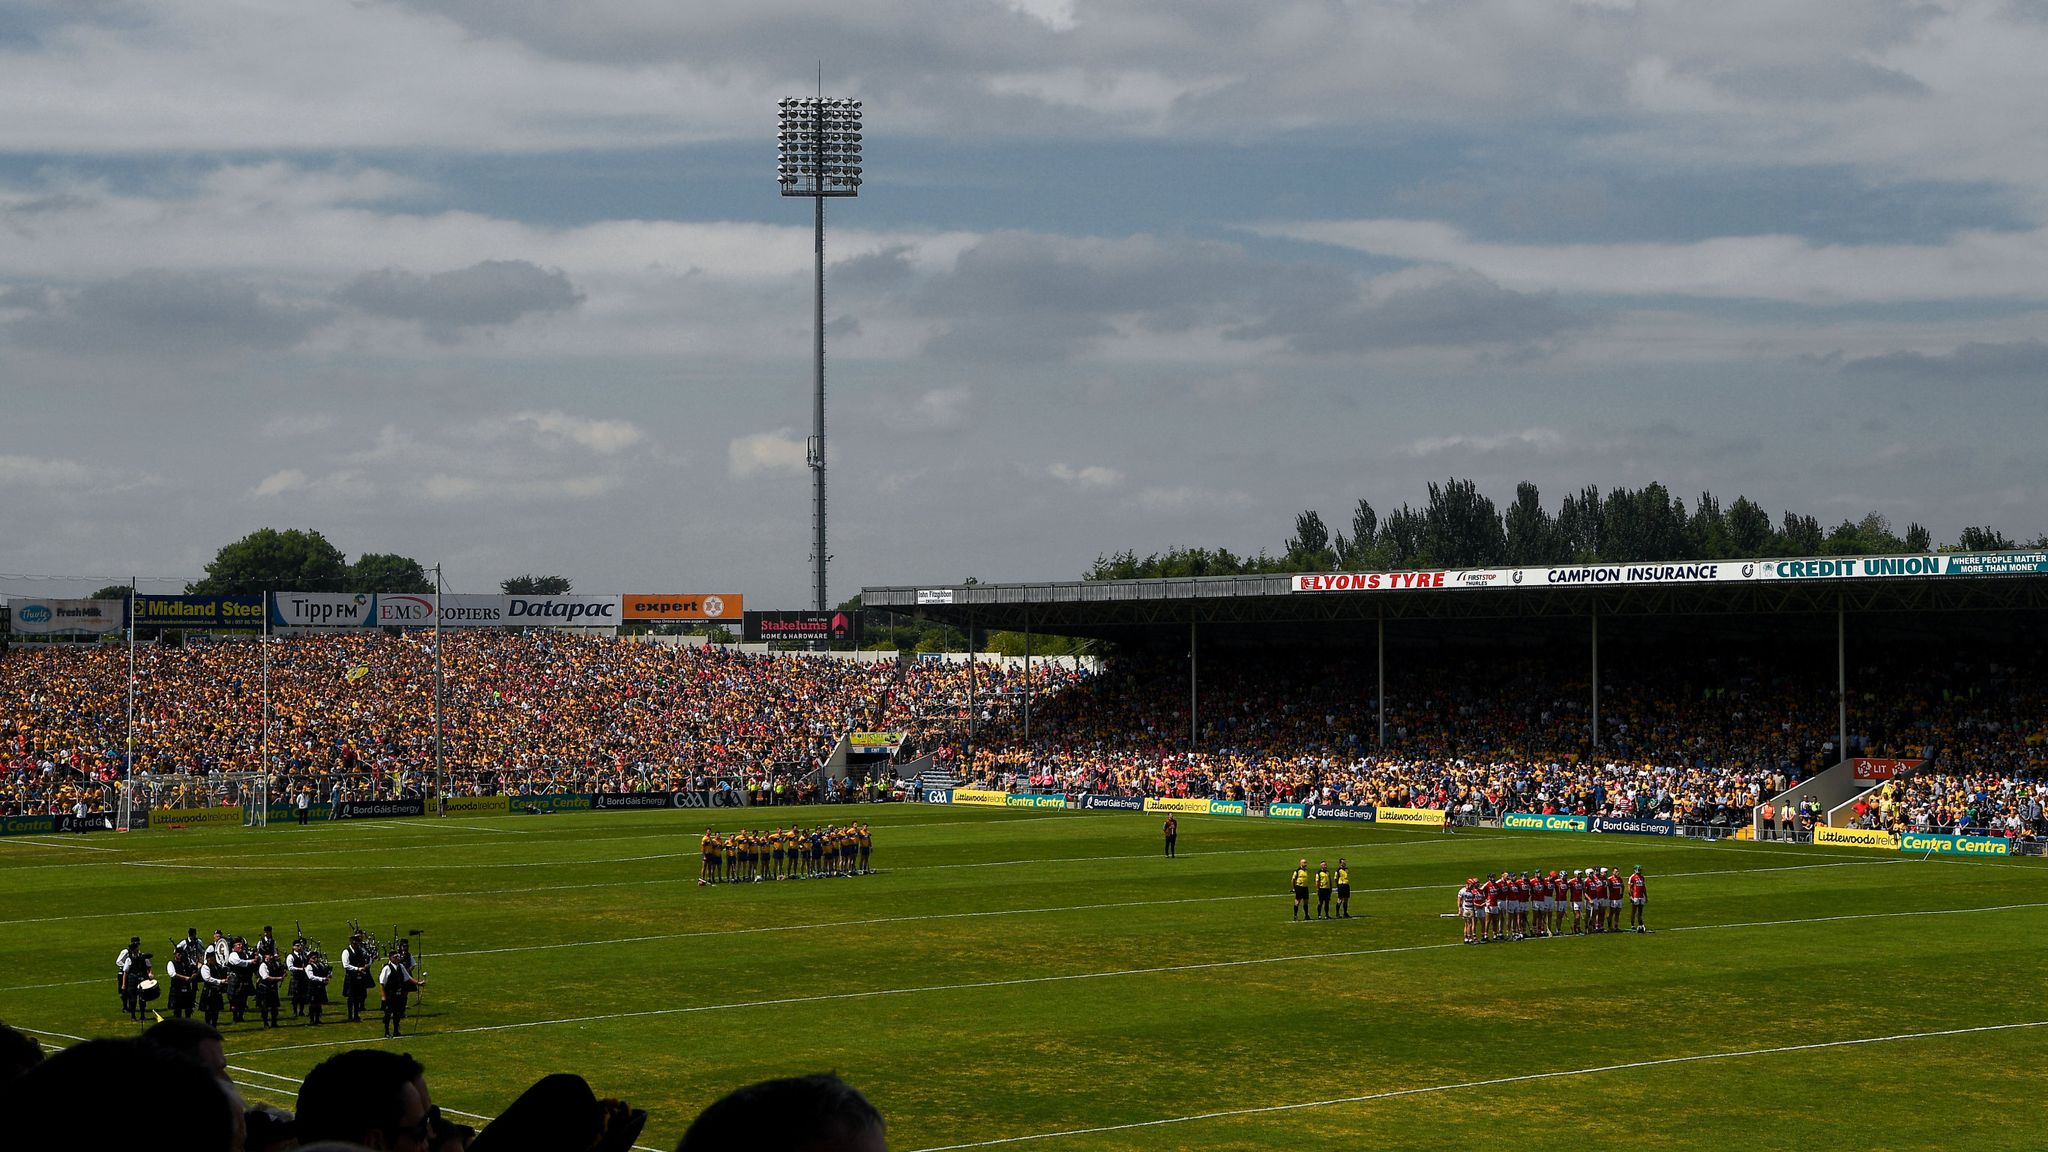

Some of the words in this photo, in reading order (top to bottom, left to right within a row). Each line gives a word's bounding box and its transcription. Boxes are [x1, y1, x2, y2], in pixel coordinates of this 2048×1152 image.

[1952, 557, 1980, 565] WHERE
[1981, 556, 2012, 564] PEOPLE
[2014, 554, 2047, 563] MATTER
[1776, 560, 1856, 578] CREDIT
[1864, 557, 1940, 576] UNION
[1960, 565, 1983, 573] MORE
[1985, 564, 2007, 572] THAN
[2009, 563, 2038, 571] MONEY
[1547, 568, 1620, 583] CAMPION
[1626, 565, 1718, 581] INSURANCE
[1312, 574, 1381, 590] LYONS
[1388, 572, 1445, 588] TYRE
[56, 607, 82, 617] Fresh
[82, 607, 102, 617] Milk
[148, 600, 217, 616] Midland
[292, 599, 333, 622] Tipp
[336, 604, 358, 618] FM
[380, 604, 422, 620] EMS
[435, 607, 500, 620] COPIERS
[508, 599, 615, 622] Datapac
[635, 601, 698, 613] expert
[761, 620, 828, 630] Stakelums
[1873, 764, 1887, 773] LIT
[553, 797, 590, 808] Centra
[606, 797, 625, 805] Bord
[641, 796, 667, 806] Energy
[954, 792, 987, 803] Littlewoods
[1007, 796, 1034, 806] Centra
[1036, 797, 1064, 808] Centra
[353, 805, 373, 814] Bord
[373, 804, 391, 814] Gáis
[391, 804, 420, 814] Energy
[1094, 798, 1108, 806] Bord
[1120, 800, 1141, 810] Energy
[1210, 802, 1243, 814] Centra
[1270, 804, 1303, 817] Centra
[1317, 808, 1333, 816] Bord
[1334, 808, 1348, 818] Gáis
[1349, 809, 1373, 820] Energy
[1379, 810, 1422, 821] Littlewoods
[152, 812, 208, 824] Littlewoods
[208, 811, 240, 821] Ireland
[1505, 815, 1543, 828] Centra
[7, 820, 52, 831] Centra
[1602, 818, 1622, 831] Bord
[1622, 821, 1640, 832] Gáis
[1640, 822, 1670, 835] Energy
[1818, 831, 1875, 844] Littlewoods
[1902, 836, 1952, 850] Centra
[1955, 838, 2007, 854] Centra
